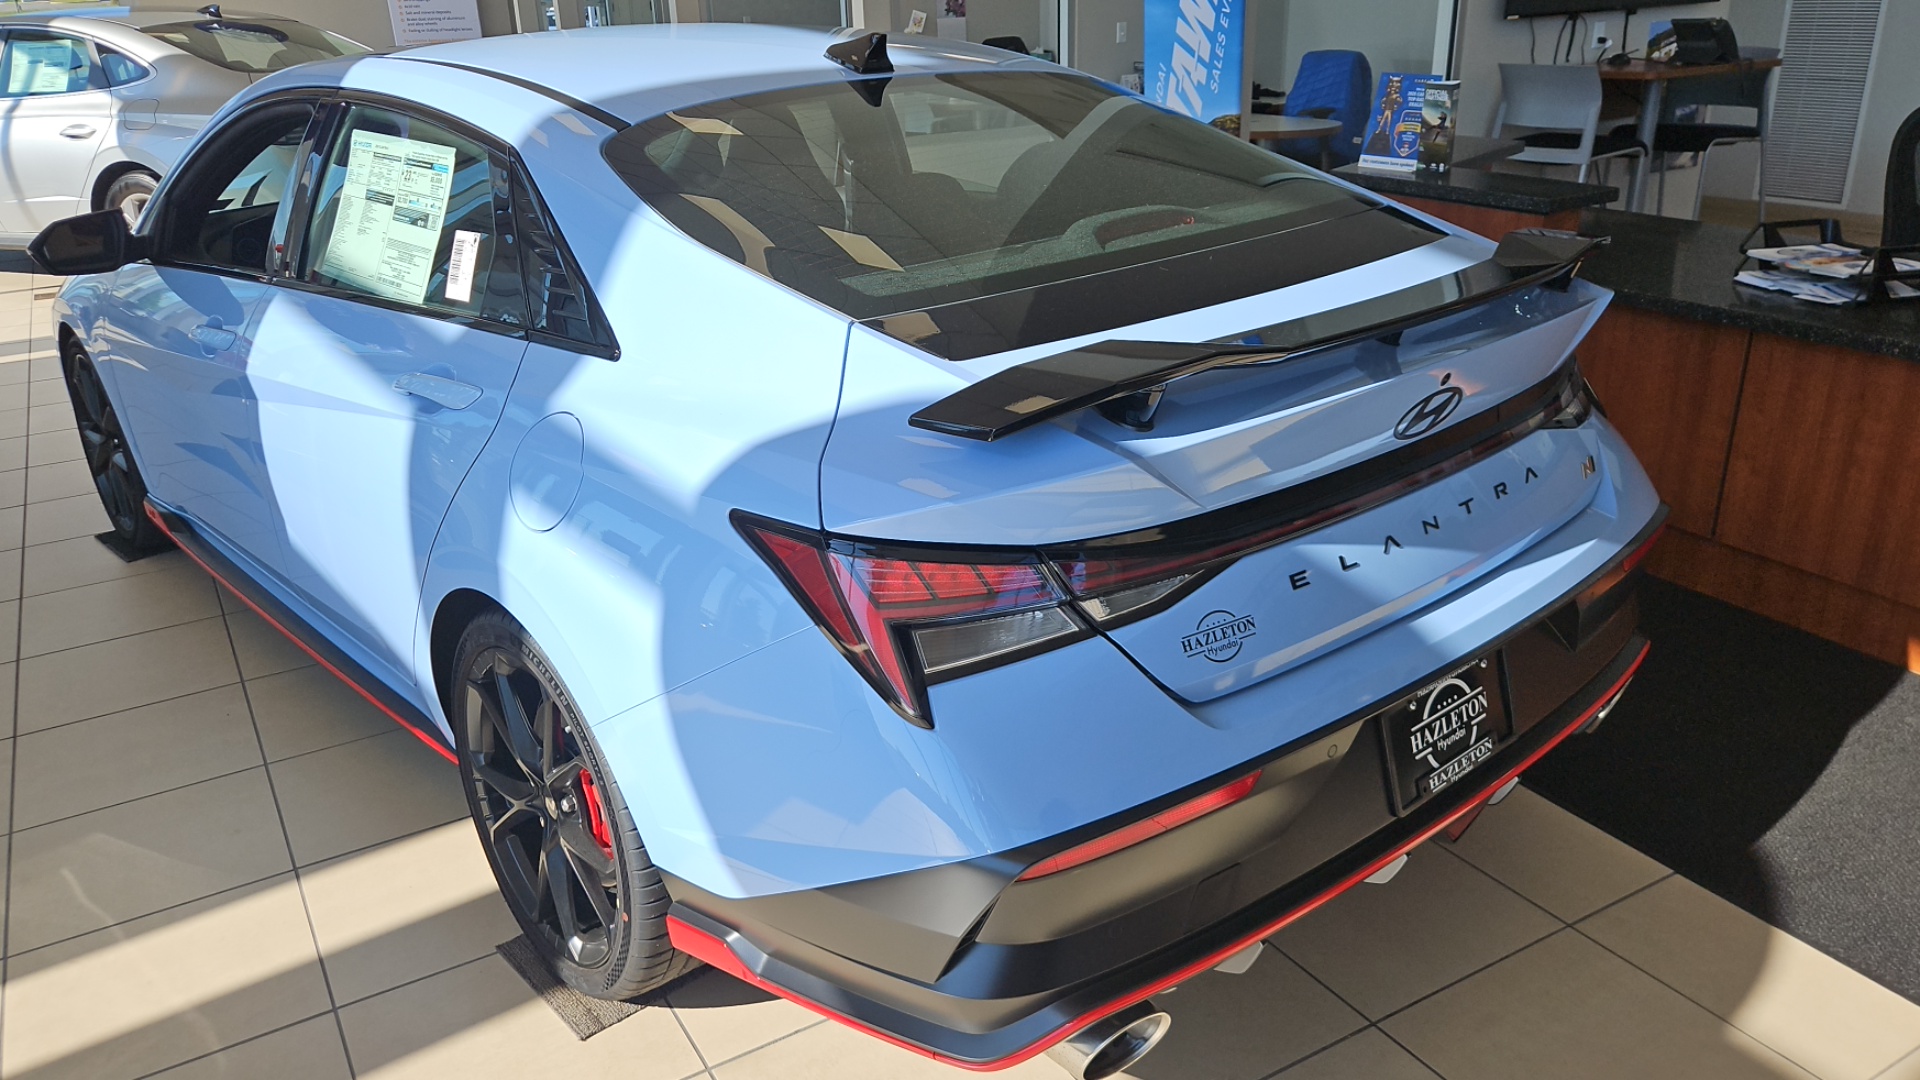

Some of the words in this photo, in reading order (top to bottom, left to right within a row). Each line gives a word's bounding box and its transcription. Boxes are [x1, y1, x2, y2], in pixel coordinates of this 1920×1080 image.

[1166, 0, 1218, 117] TAW
[1210, 32, 1226, 94] SALES
[1220, 0, 1233, 28] EV
[1289, 467, 1538, 590] ELANTRA
[1181, 617, 1256, 653] HAZLETON
[1207, 638, 1238, 656] Hyundai
[521, 644, 568, 707] MICHELIN
[570, 712, 585, 738] PILOT
[584, 740, 599, 772] SPORT
[1410, 691, 1488, 754] HAZLETON
[1437, 725, 1466, 750] Hyundai
[1429, 739, 1493, 790] HAZLETON
